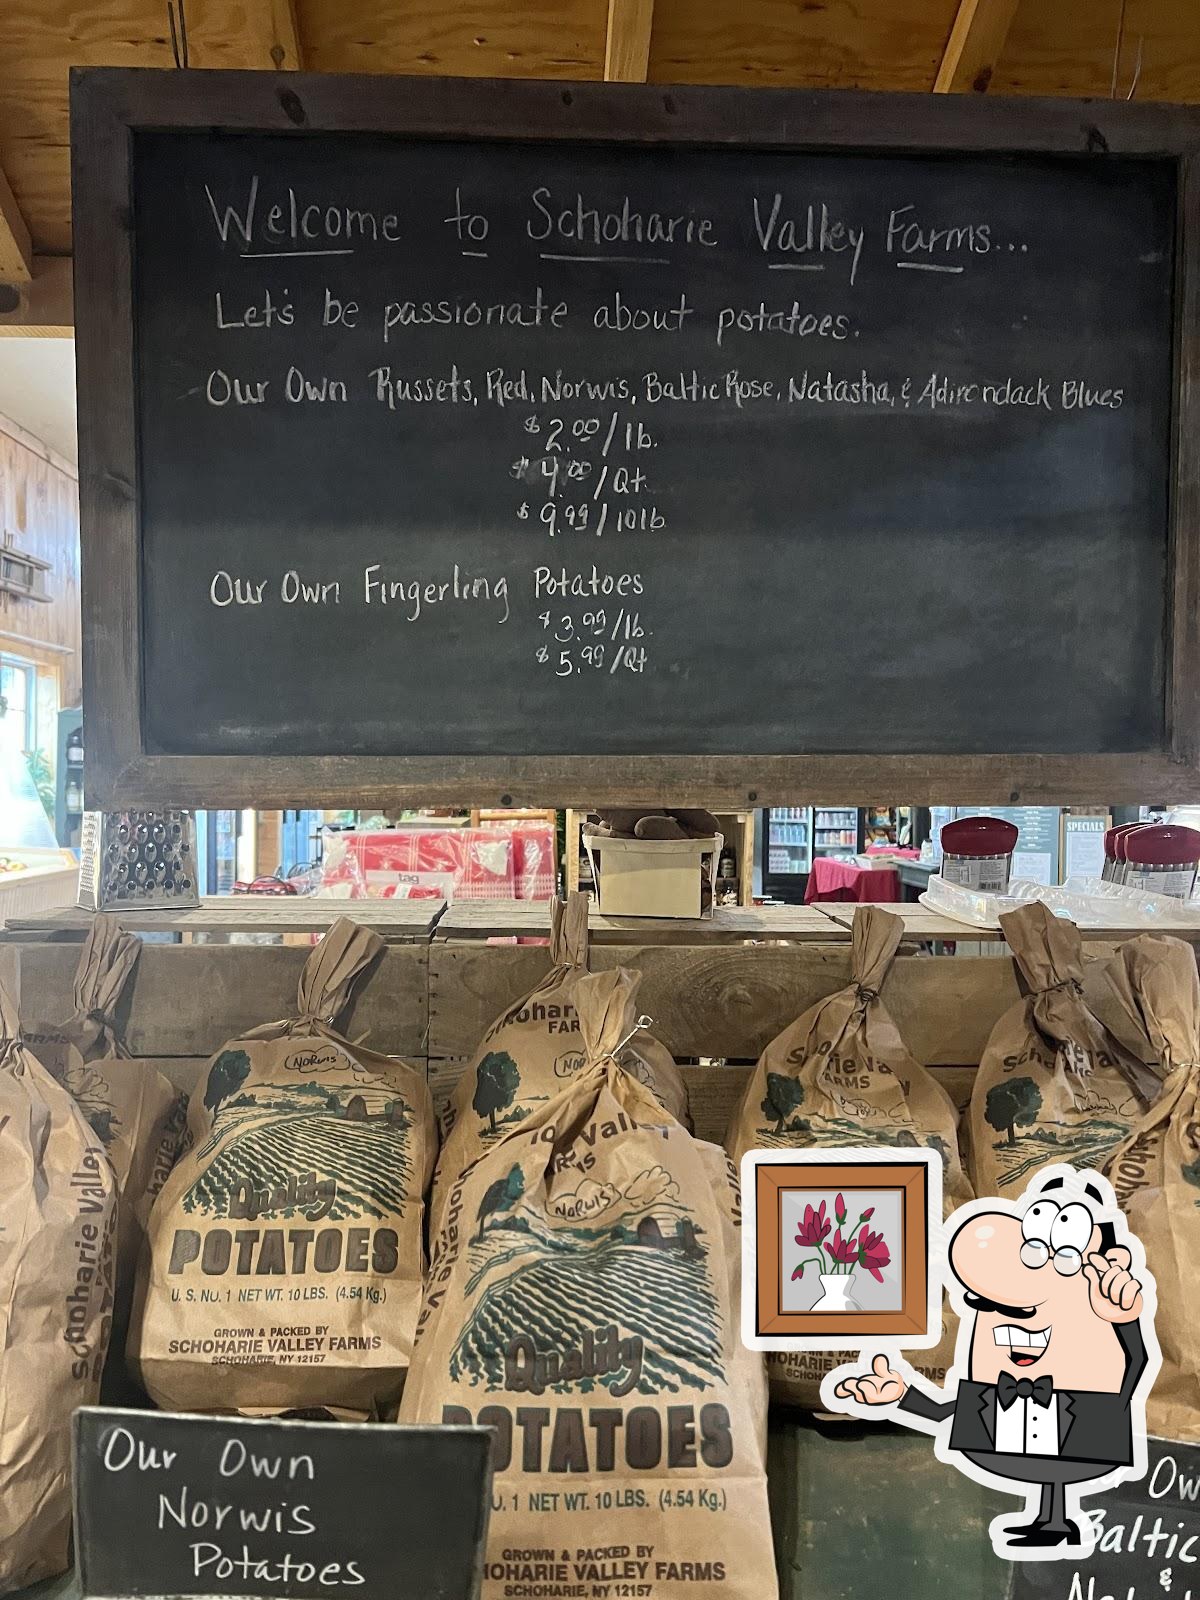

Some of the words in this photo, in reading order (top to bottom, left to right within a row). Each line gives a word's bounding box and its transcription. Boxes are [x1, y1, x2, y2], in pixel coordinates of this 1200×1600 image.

[204, 175, 400, 242] Welcome
[444, 187, 489, 240] to
[527, 187, 718, 247] Schoharie
[753, 193, 865, 286] Valley
[324, 287, 359, 328] be
[384, 286, 568, 343] passionate
[593, 292, 694, 332] about
[717, 301, 860, 347] potatoes.
[206, 368, 271, 407] Our
[285, 365, 348, 402] Own
[642, 370, 724, 404] Baltic
[1061, 378, 1125, 409] Blues
[210, 570, 268, 607] Our
[280, 569, 340, 604] Own
[364, 564, 510, 623] Fingerling
[532, 564, 645, 598] Potatoes
[1066, 821, 1105, 832] SPECIALS
[228, 1171, 338, 1222] Quality
[167, 1227, 400, 1276] POTATOES
[225, 1289, 231, 1303] 1
[238, 1288, 261, 1302] NET
[264, 1288, 285, 1302] WT.
[287, 1288, 301, 1302] 10
[304, 1286, 329, 1300] LBS.
[335, 1286, 363, 1303] (4.54
[365, 1286, 387, 1303] Kg.)
[168, 1338, 265, 1355] SCHOHARIE
[267, 1337, 326, 1352] VALLEY
[329, 1335, 382, 1351] FARMS
[213, 1327, 255, 1339] GROWN
[259, 1328, 266, 1338] &
[270, 1327, 312, 1337] PACKED
[315, 1326, 330, 1336] BY
[279, 1354, 294, 1365] NY
[296, 1354, 326, 1365] 12157
[504, 1323, 644, 1398] Quality
[103, 1428, 177, 1472] Our
[218, 1438, 315, 1480] Own
[157, 1486, 317, 1536] Norwis
[528, 1492, 560, 1512] NET
[564, 1492, 591, 1512] WT.
[594, 1491, 612, 1511] 10
[615, 1490, 650, 1509] LBS.
[658, 1488, 695, 1513] (4.54
[698, 1488, 727, 1512] Kg.)
[189, 1541, 367, 1586] Potatoes
[502, 1548, 556, 1562] GROWN
[561, 1549, 571, 1561] &
[576, 1546, 631, 1561] PACKED
[636, 1545, 655, 1559] BY
[574, 1562, 652, 1581] VALLEY
[655, 1562, 726, 1581] FARMS
[504, 1584, 590, 1598] SCHOHARIE,
[592, 1584, 610, 1598] NY
[614, 1584, 653, 1598] 12157
